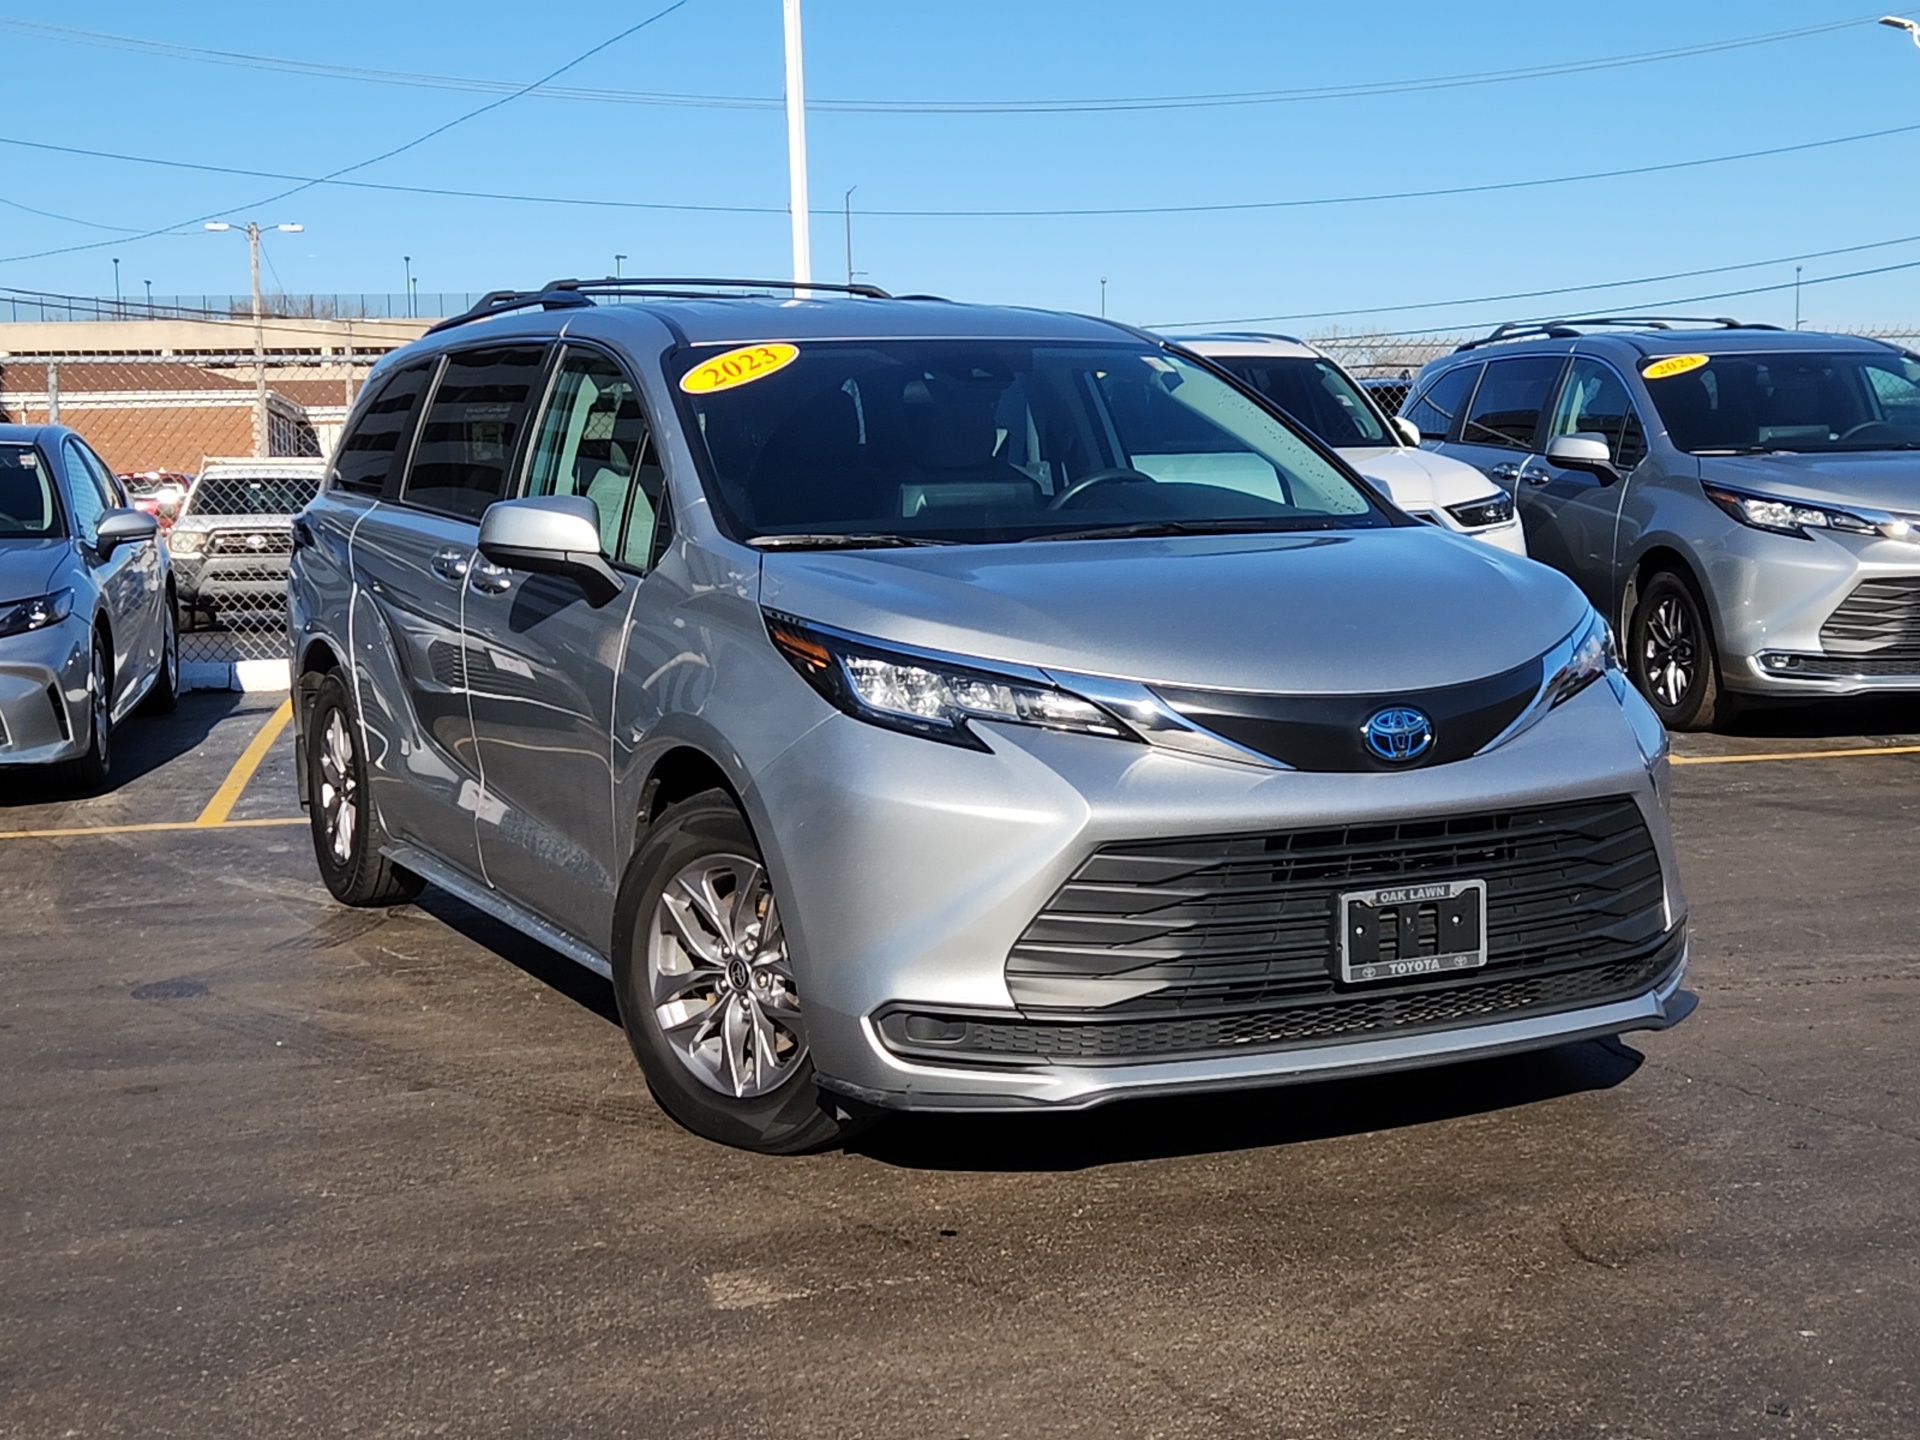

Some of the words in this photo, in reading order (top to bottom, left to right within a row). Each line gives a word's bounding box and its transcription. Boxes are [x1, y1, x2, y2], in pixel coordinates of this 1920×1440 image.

[703, 348, 778, 387] 2023
[1380, 891, 1406, 903] OAK
[1409, 886, 1445, 900] LAWN
[1389, 959, 1440, 975] TOYOTA
